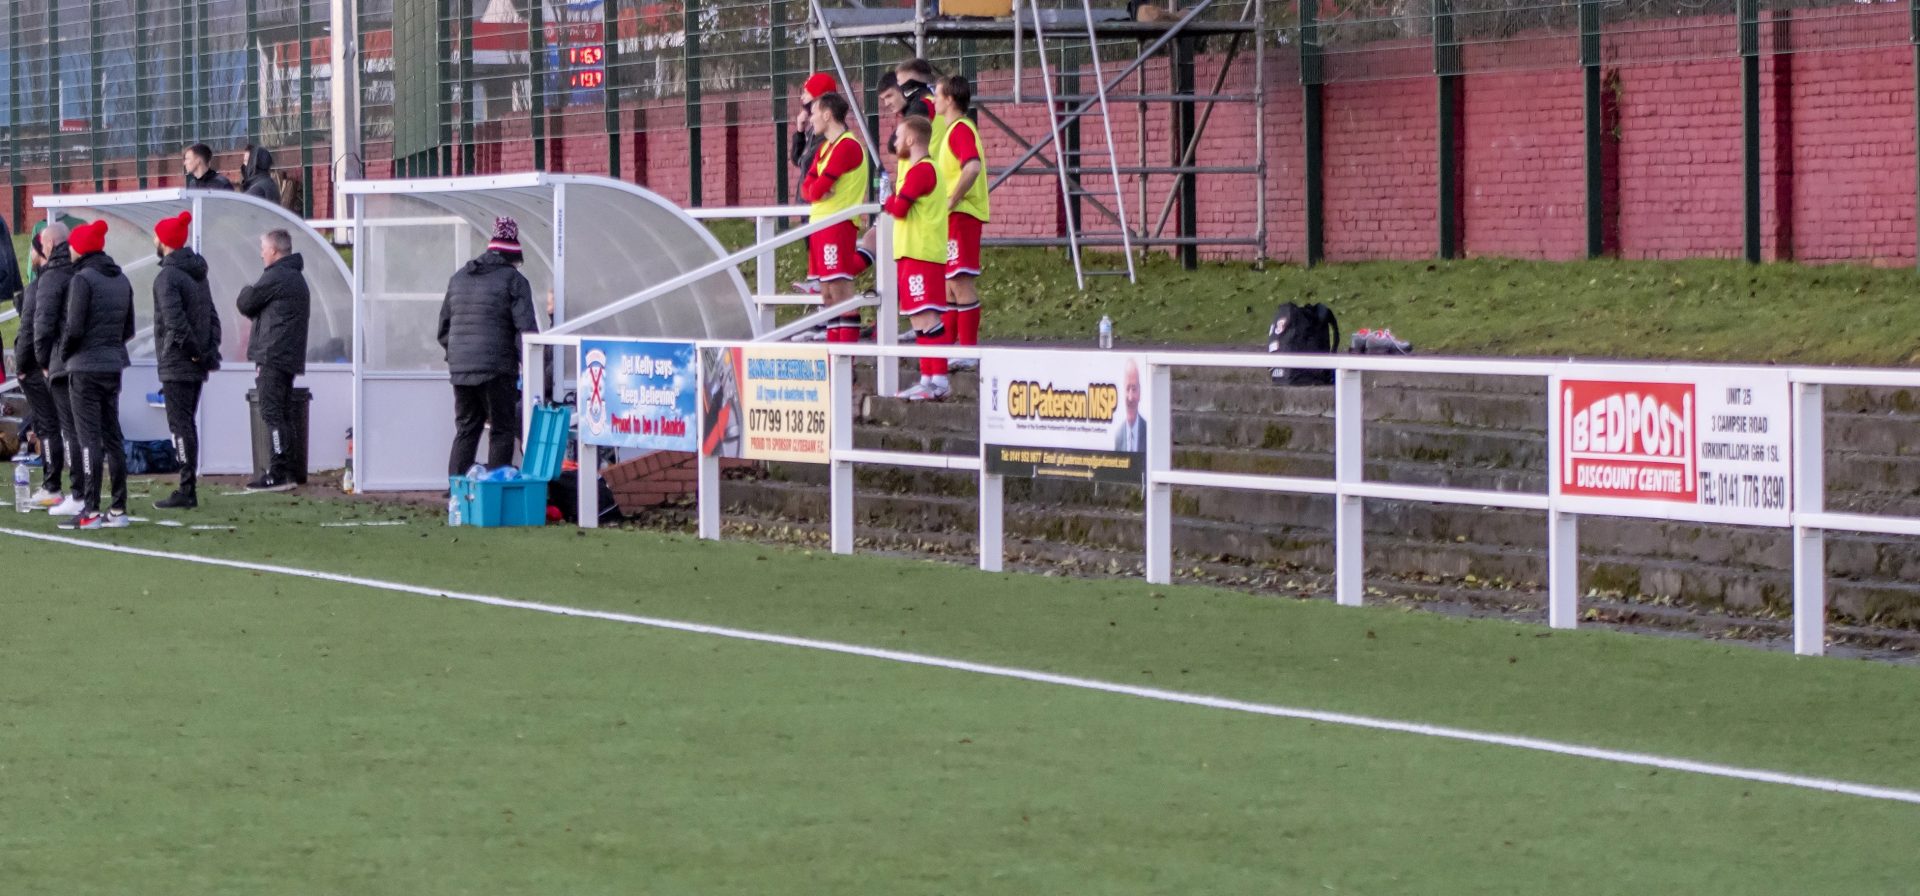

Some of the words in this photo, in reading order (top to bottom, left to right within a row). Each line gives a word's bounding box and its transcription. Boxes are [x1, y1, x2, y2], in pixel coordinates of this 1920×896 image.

[622, 355, 633, 375] Del
[634, 355, 654, 379] Kelly
[655, 359, 673, 379] says
[1008, 380, 1028, 420] Gil
[1028, 380, 1088, 421] Paterson
[1088, 382, 1118, 423] MSP
[1726, 388, 1741, 405] UNIT
[1743, 388, 1752, 406] 25
[611, 413, 631, 434] Proud
[633, 414, 640, 435] to
[642, 414, 652, 435] be
[653, 418, 659, 436] a
[660, 415, 686, 437] Bankie
[749, 408, 781, 433] 07799
[785, 409, 804, 433] 138
[806, 410, 825, 434] 266
[1572, 392, 1683, 457] BEDPOST
[1712, 415, 1716, 433] 3
[1717, 415, 1747, 433] CAMPSIE
[1749, 416, 1768, 434] ROAD
[751, 437, 765, 450] PROUD
[765, 437, 771, 450] TO
[771, 437, 792, 452] SPONSOR
[792, 439, 817, 453] CLYDEBANK
[1009, 450, 1020, 462] 0141
[1701, 442, 1749, 461] KIRKINTILLOCH
[1751, 444, 1765, 462] G66
[1767, 445, 1780, 463] 1SL
[1577, 464, 1639, 490] DISCOUNT
[1638, 467, 1682, 493] CENTRE
[1699, 471, 1716, 506] TEL:
[1718, 473, 1739, 507] 0141
[1742, 474, 1759, 508] 776
[1761, 475, 1785, 510] 8390
